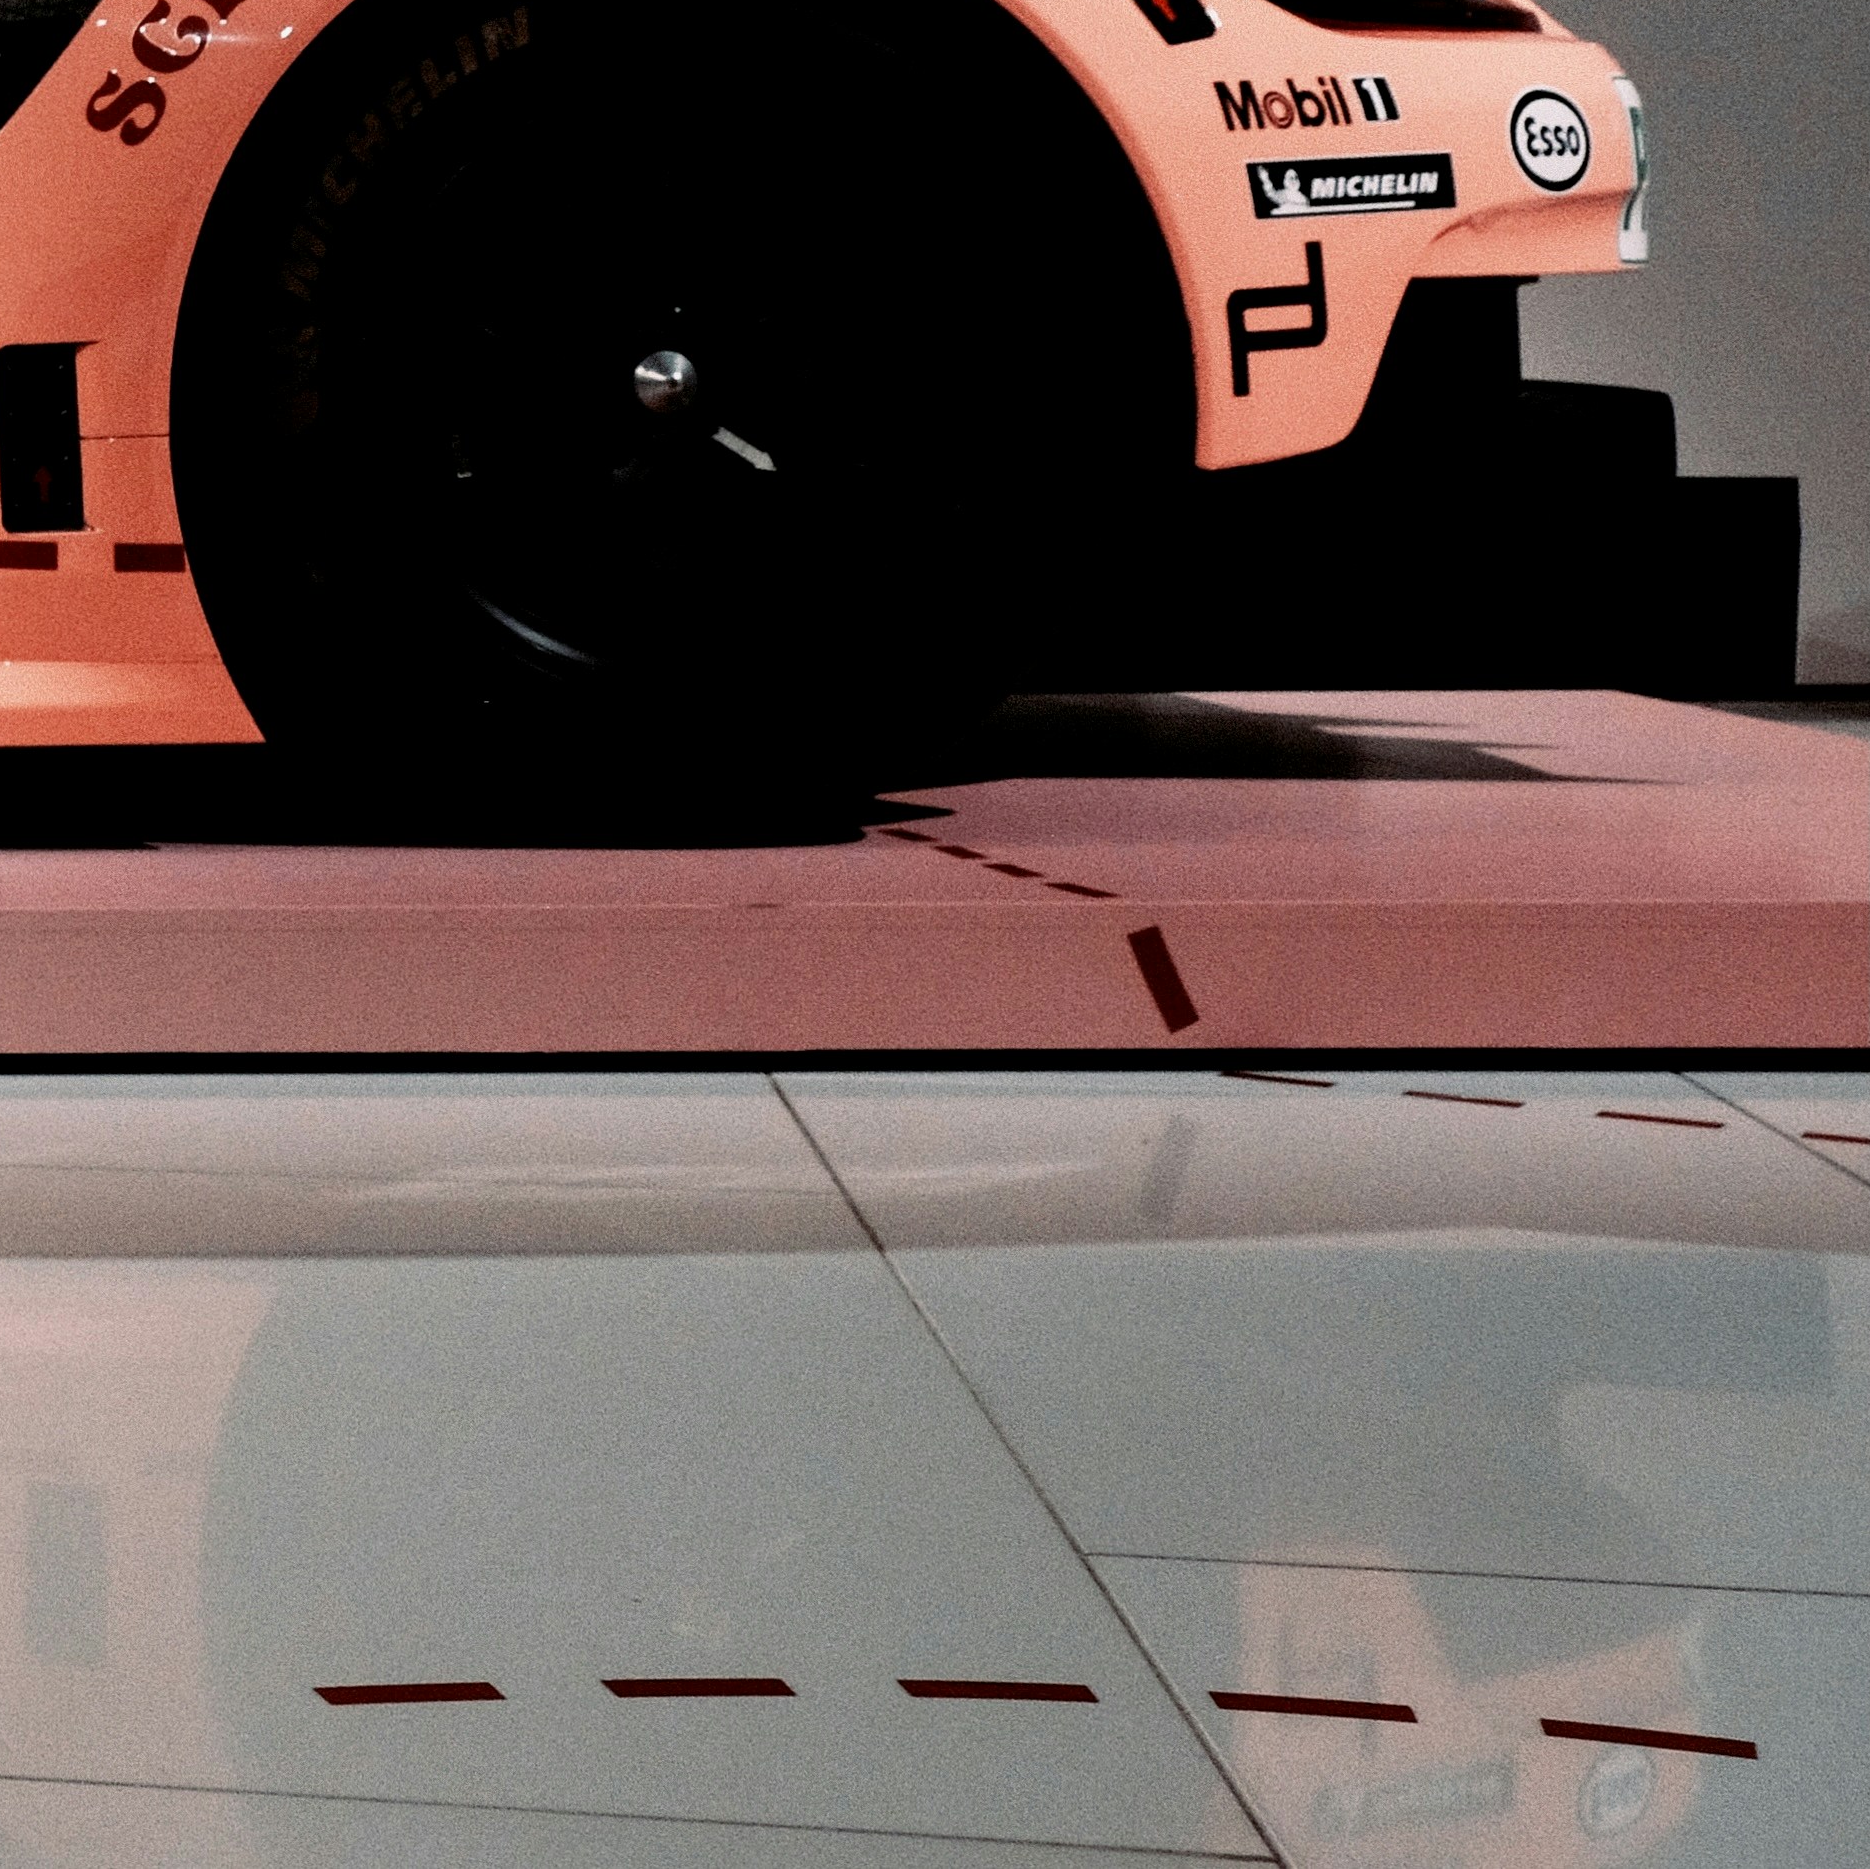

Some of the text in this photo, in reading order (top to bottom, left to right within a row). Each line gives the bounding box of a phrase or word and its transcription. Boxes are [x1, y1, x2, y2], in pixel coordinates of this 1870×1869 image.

[1213, 76, 1390, 131] Mobil 1
[1310, 171, 1438, 200] MICHELIN
